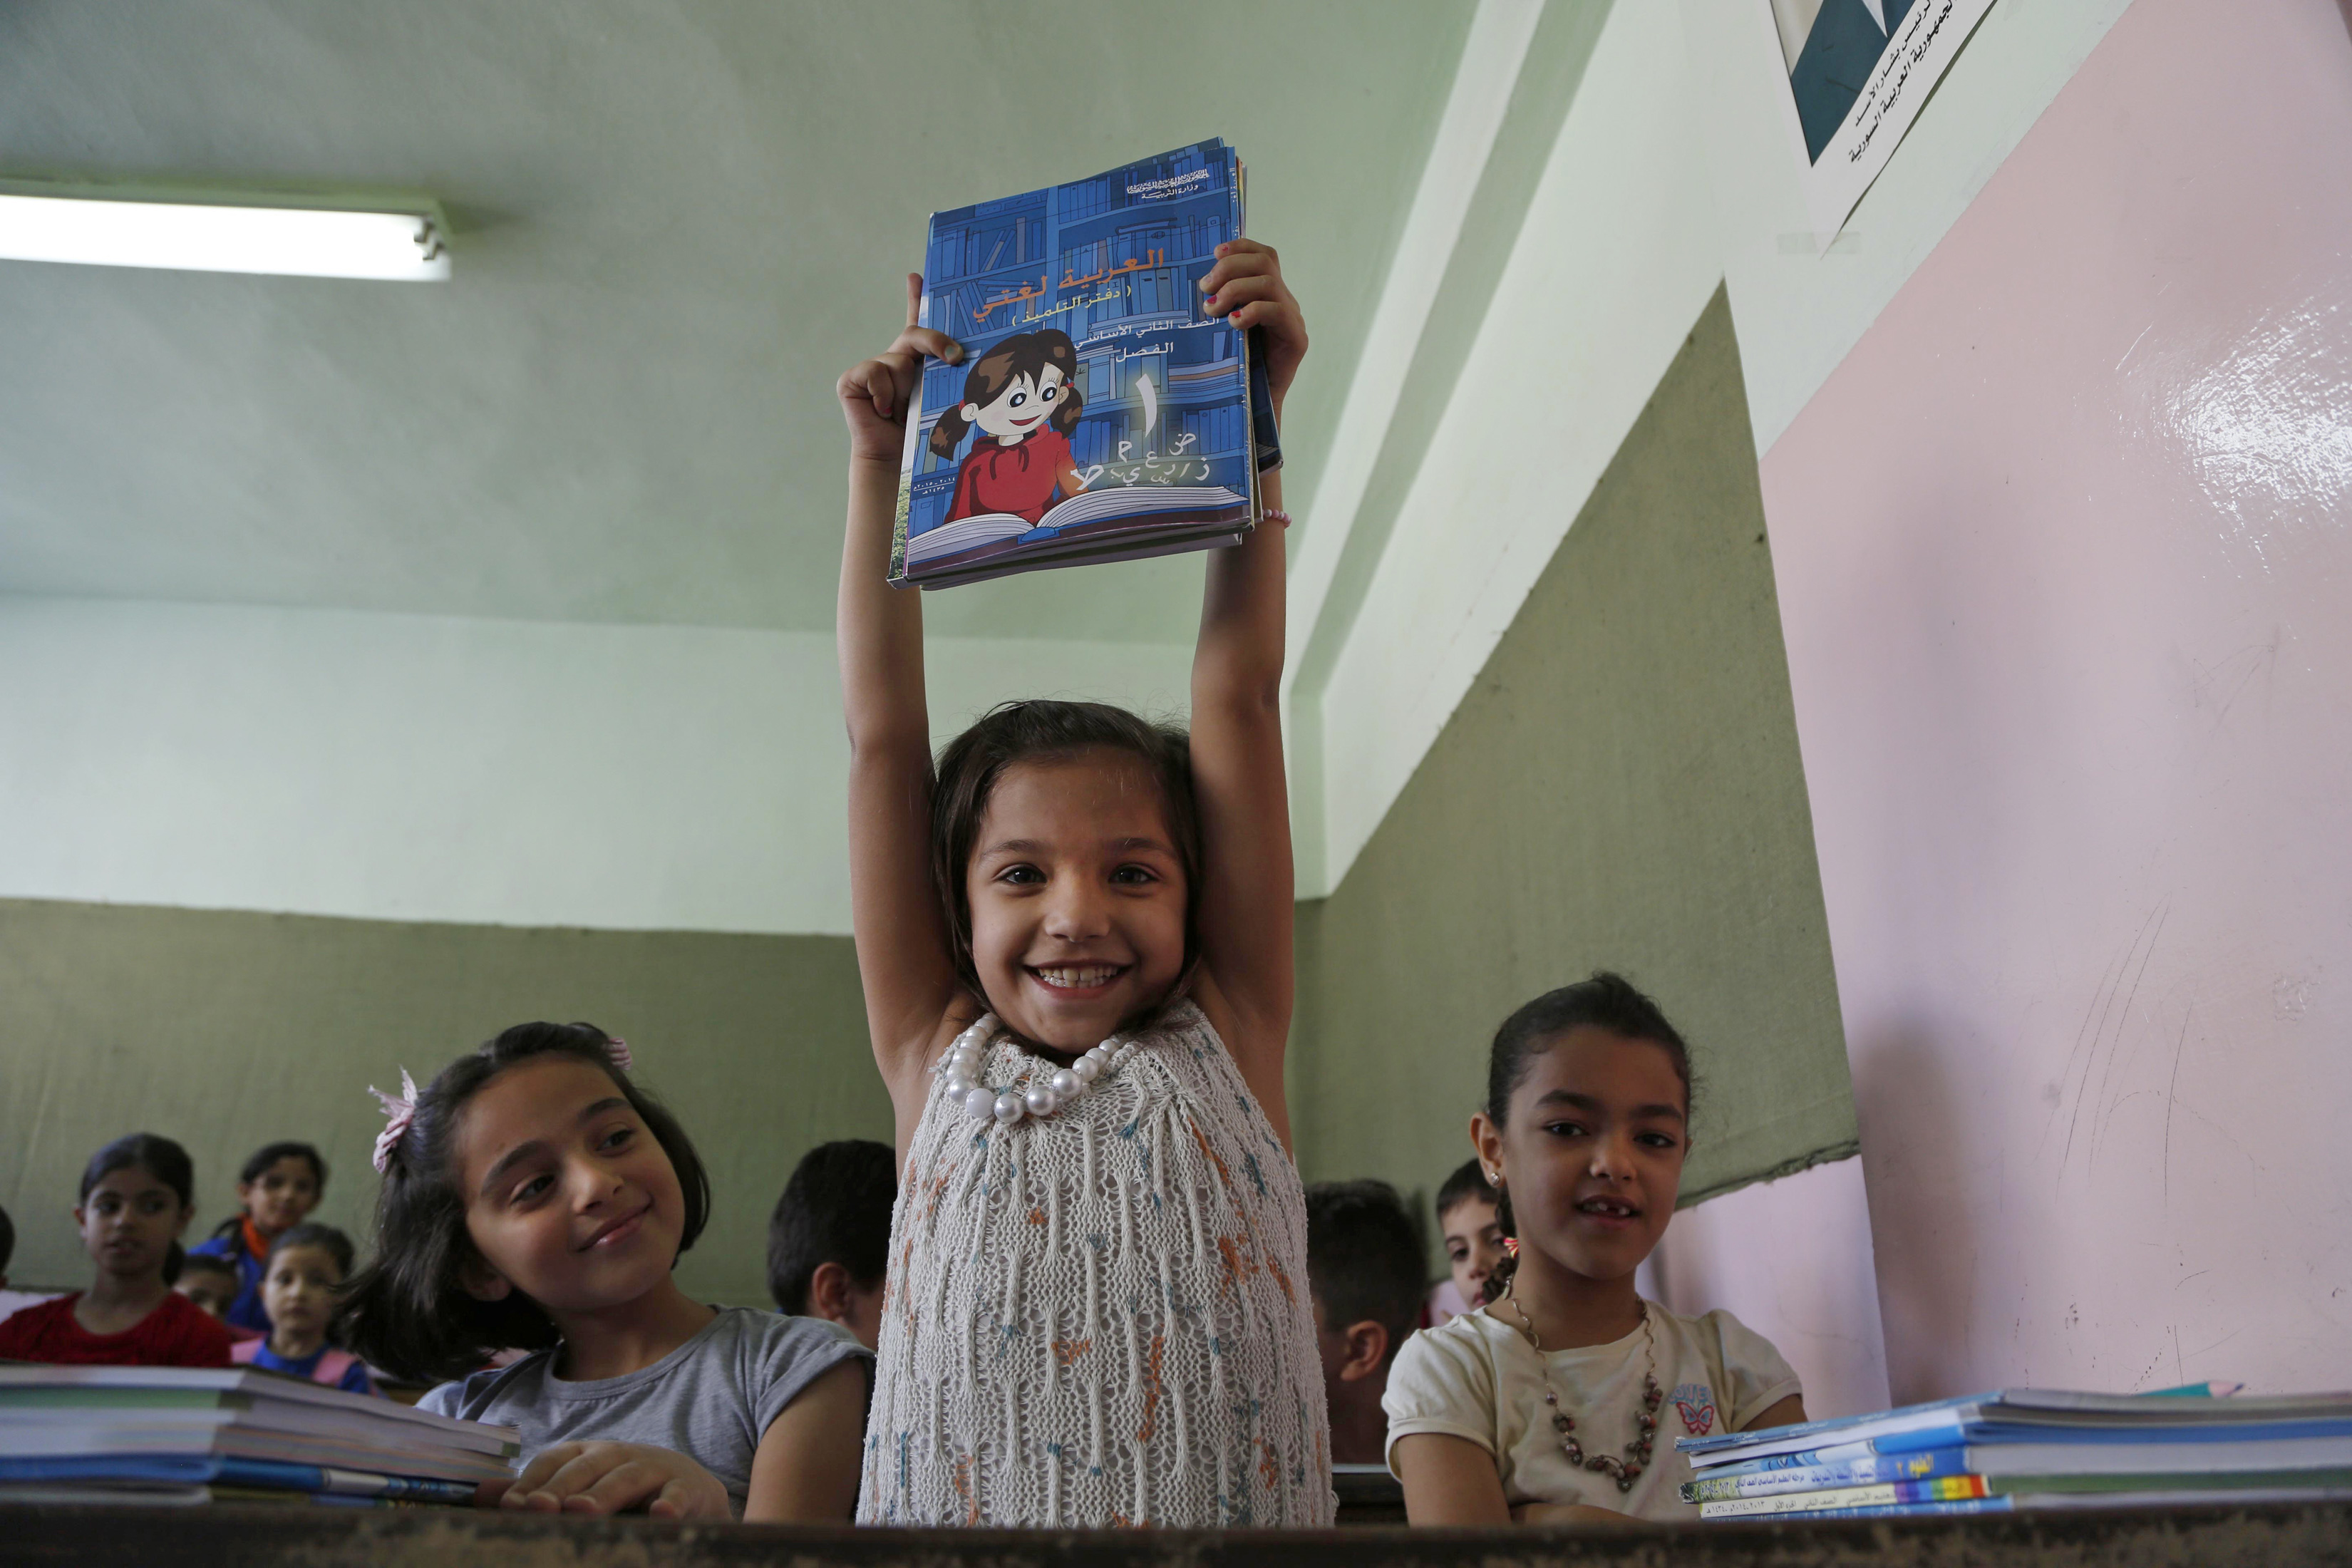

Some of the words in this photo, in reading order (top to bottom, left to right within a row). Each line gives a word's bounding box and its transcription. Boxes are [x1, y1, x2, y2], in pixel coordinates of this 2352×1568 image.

[1902, 0, 1934, 51] لرئيس
[1910, 0, 1957, 63] لجمهورية
[1880, 48, 1900, 88] بشار
[1880, 60, 1911, 113] العربية
[1849, 110, 1881, 163] السورية
[1127, 180, 1157, 194] السورية
[1157, 176, 1179, 190] العربية
[1178, 168, 1210, 185] الجمهورية
[1178, 185, 1199, 194] وزارة
[1058, 247, 1163, 289] العربية
[973, 275, 1048, 323] لغتي
[1022, 296, 1081, 324] التلميذ
[1085, 288, 1120, 309] دفتر
[1135, 320, 1173, 338] الثاني
[1177, 318, 1219, 329] الصف
[1074, 324, 1132, 350] الأساسي
[1115, 341, 1174, 362] الفصل
